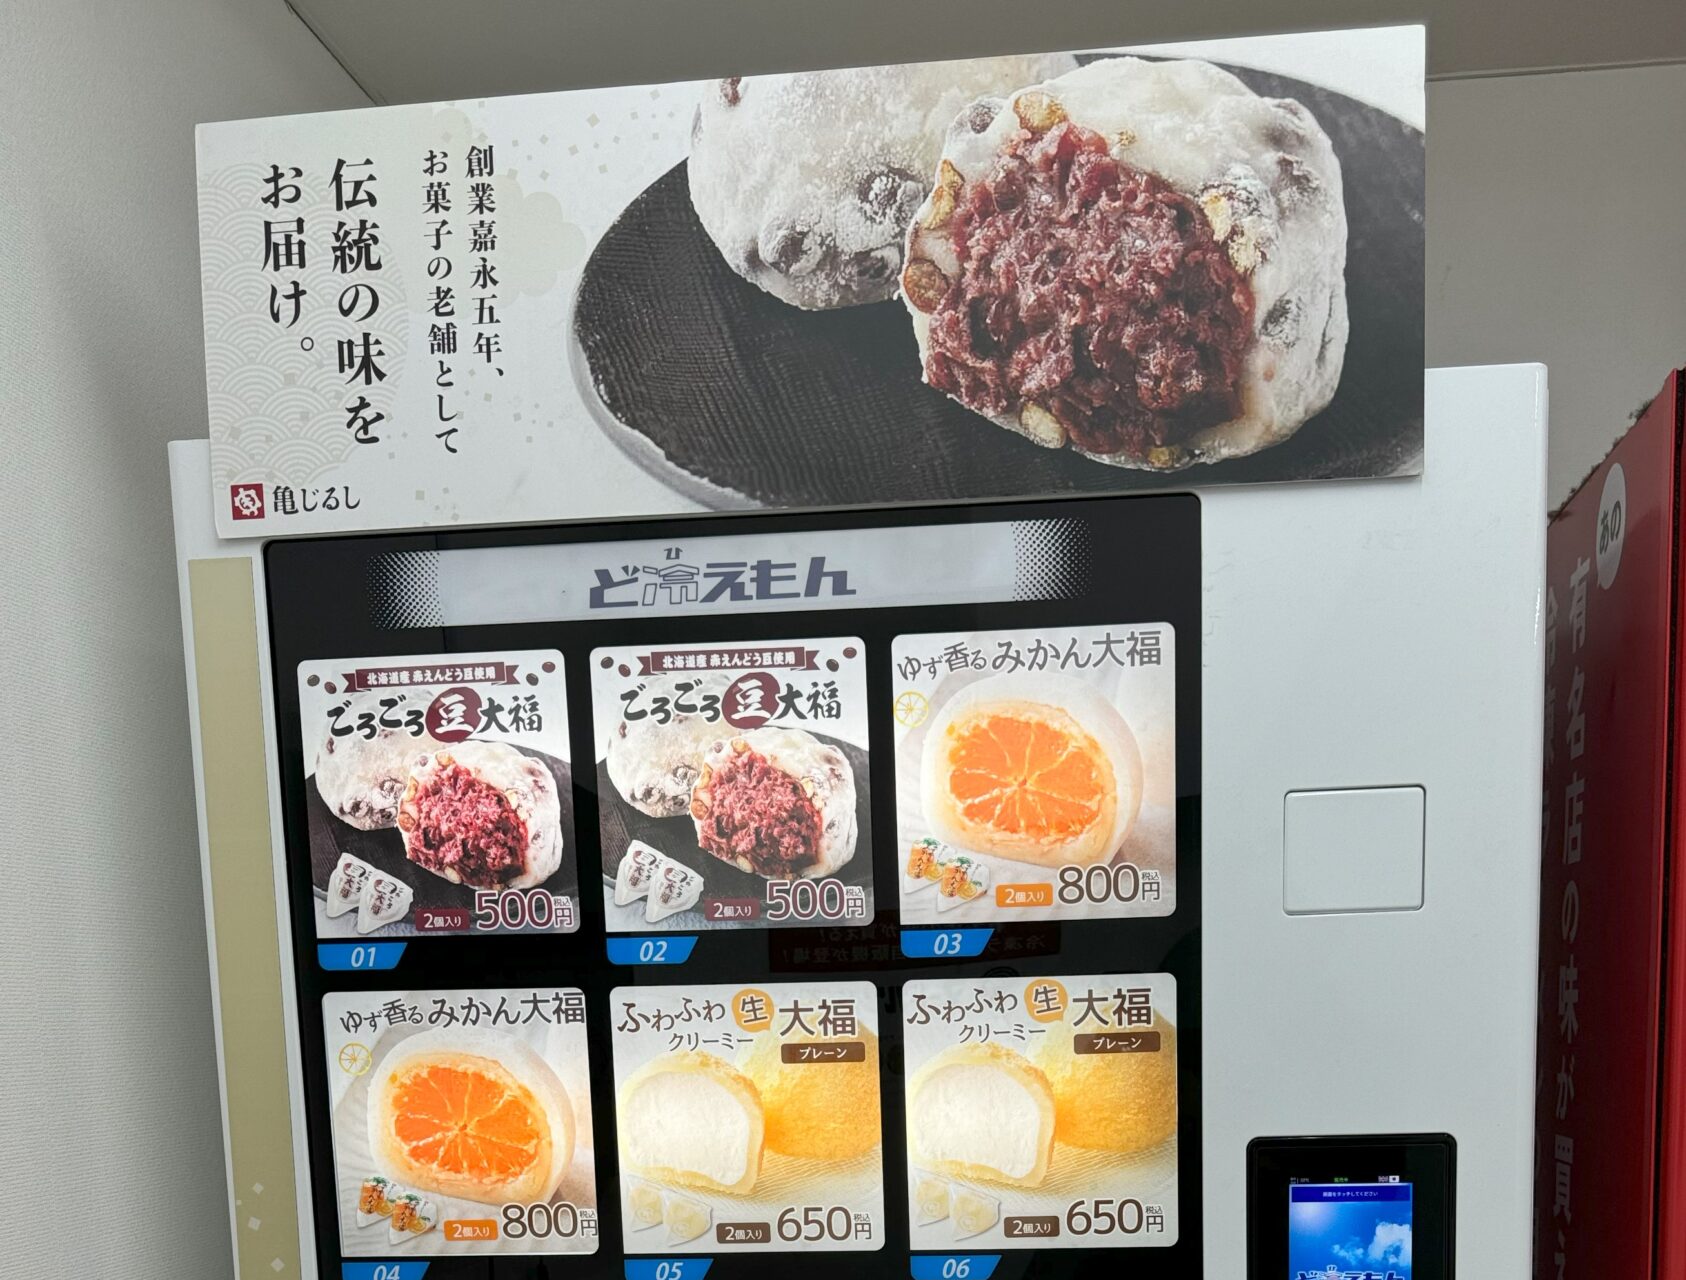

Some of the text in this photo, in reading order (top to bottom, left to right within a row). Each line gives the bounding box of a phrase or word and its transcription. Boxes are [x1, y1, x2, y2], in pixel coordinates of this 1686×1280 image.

[261, 164, 315, 352] お届け。
[465, 145, 504, 377] 創業嘉永五年、
[329, 158, 387, 445] 伝統の味を
[422, 150, 459, 454] お菓子の老舗として
[272, 485, 361, 515] 亀じるし
[589, 557, 857, 608] ど冷えもん
[897, 630, 1162, 681] ゆず香るみかん大福
[619, 678, 842, 725] ごろごろ豆大福
[326, 693, 543, 740] ごろごろ豆大福
[1004, 888, 1044, 903] 2個入り
[423, 914, 462, 928] 2個入り
[713, 903, 752, 918] 2個入り
[639, 941, 667, 961] 02
[933, 933, 962, 955] 03
[350, 947, 376, 967] 01
[339, 991, 586, 1034] ゆず香るみかん大福
[617, 996, 857, 1037] ふわふわ生大福
[907, 985, 1152, 1027] ふわふわ生大福
[668, 1032, 754, 1052] クリーミー
[959, 1023, 1046, 1043] クリーミー
[800, 1047, 848, 1060] プレーン
[1093, 1038, 1142, 1050] プレーン
[452, 1223, 490, 1238] 2個入り
[724, 1226, 763, 1241] 2個入り
[1012, 1220, 1051, 1235] 2個入り
[942, 1259, 970, 1279] 06
